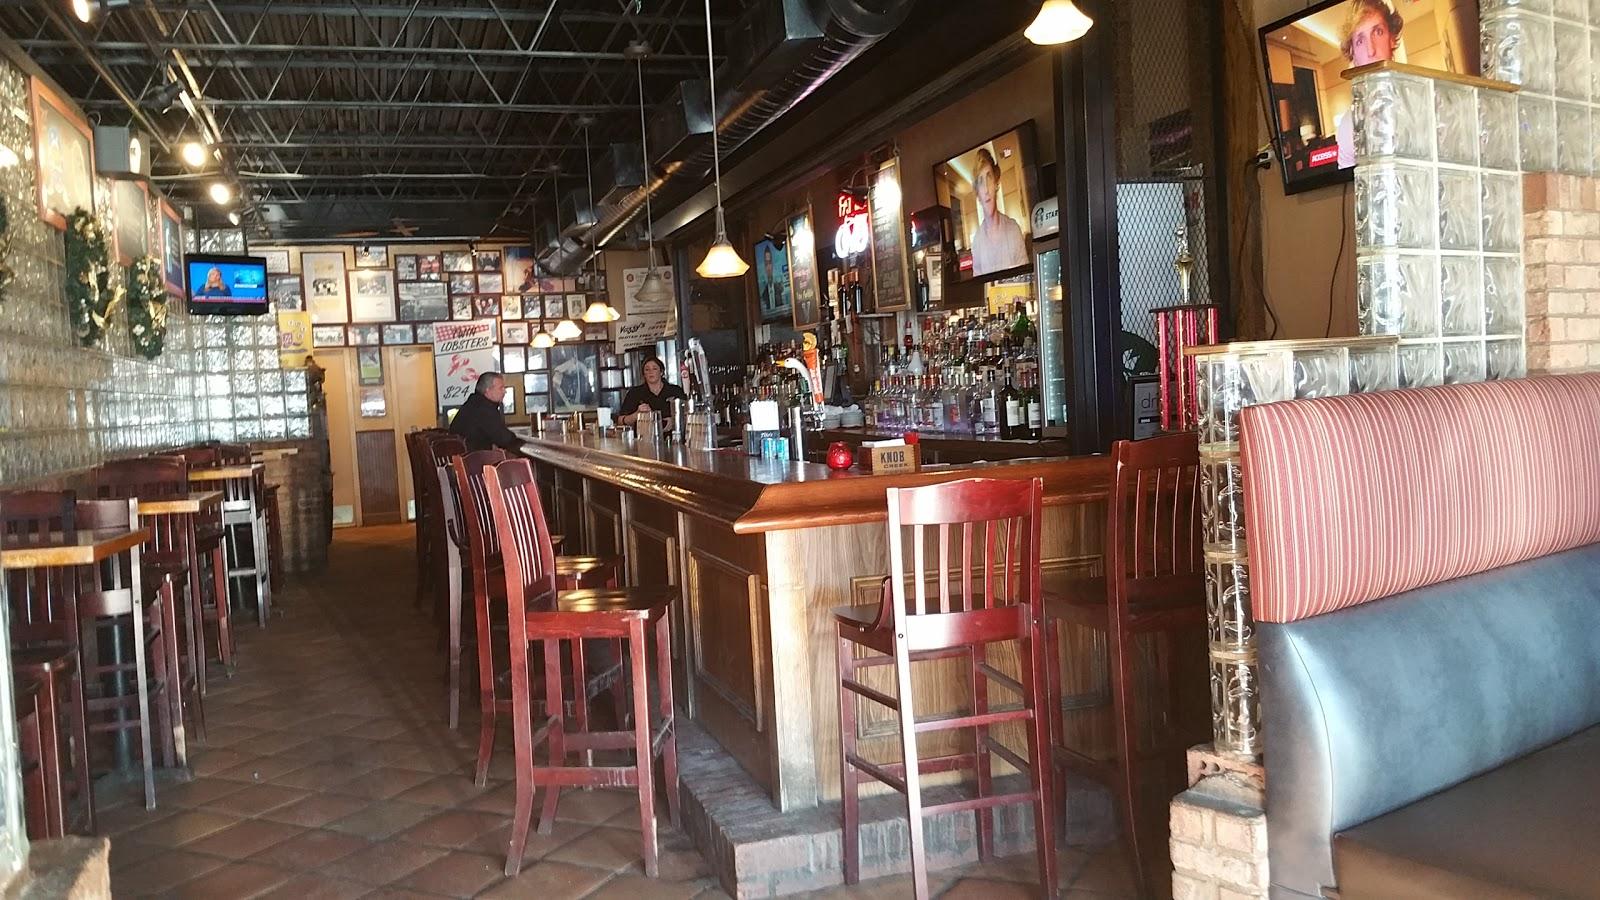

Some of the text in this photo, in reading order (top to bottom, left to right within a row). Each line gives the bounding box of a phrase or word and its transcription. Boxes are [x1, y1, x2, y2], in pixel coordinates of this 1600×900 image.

[452, 325, 477, 339] TWIN
[441, 336, 489, 352] LOBSTERS
[443, 385, 470, 399] $24
[880, 450, 905, 464] KNOB
